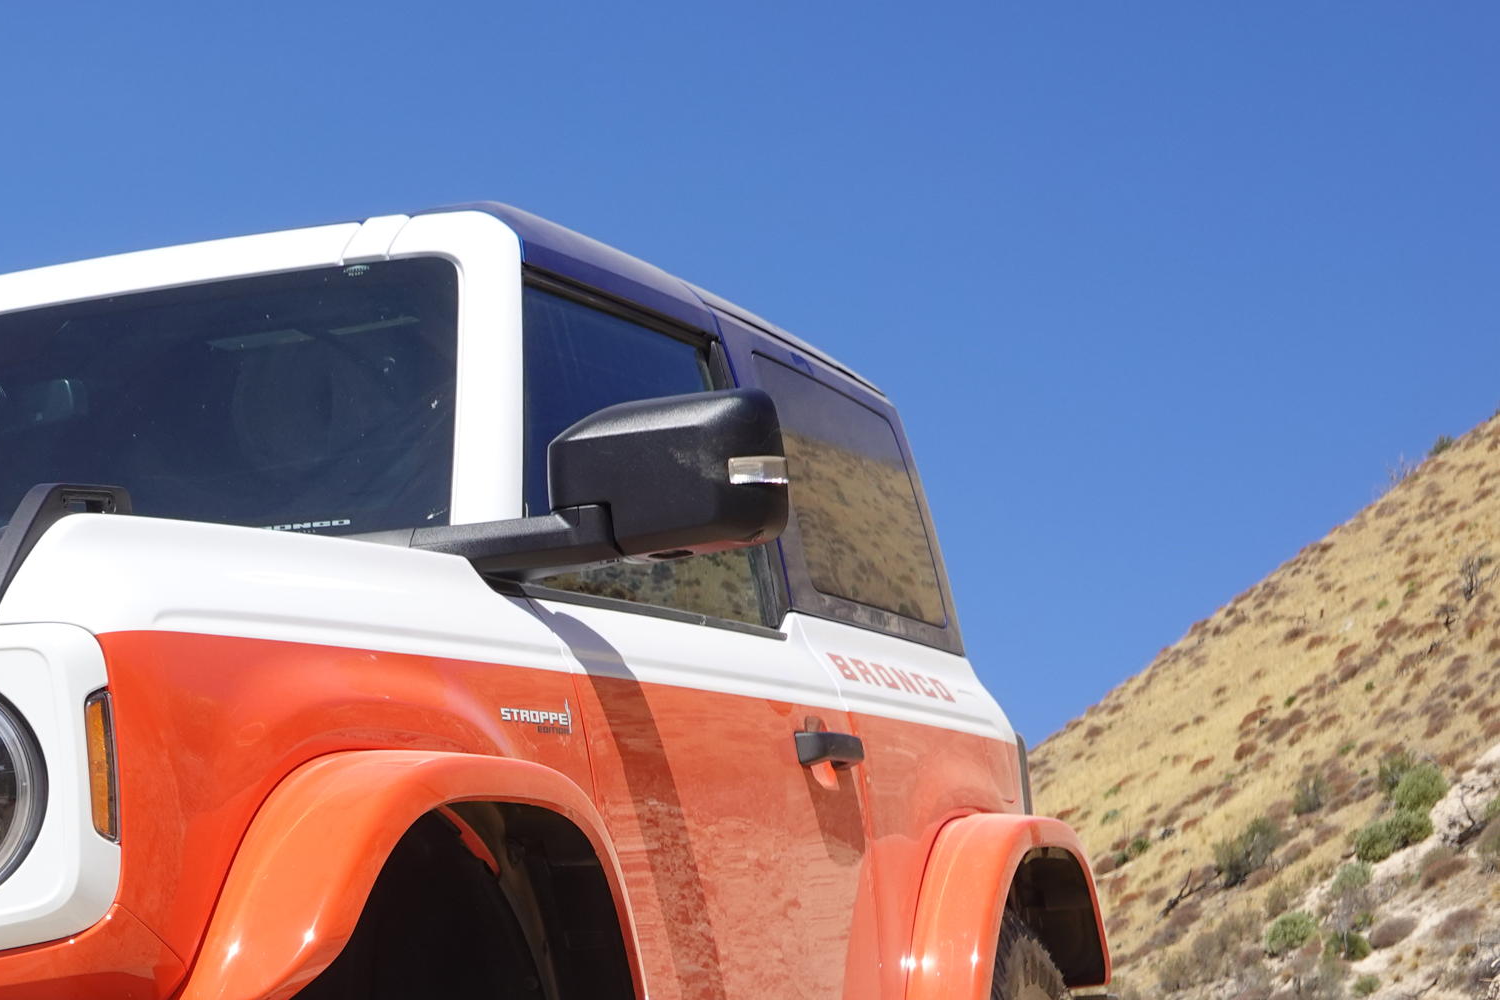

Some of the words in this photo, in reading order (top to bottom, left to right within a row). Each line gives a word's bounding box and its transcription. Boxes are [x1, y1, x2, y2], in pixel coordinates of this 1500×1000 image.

[261, 519, 351, 530] ONCO
[826, 652, 957, 703] BRONCO
[500, 707, 570, 726] STROPPE
[537, 725, 570, 735] EDITION
